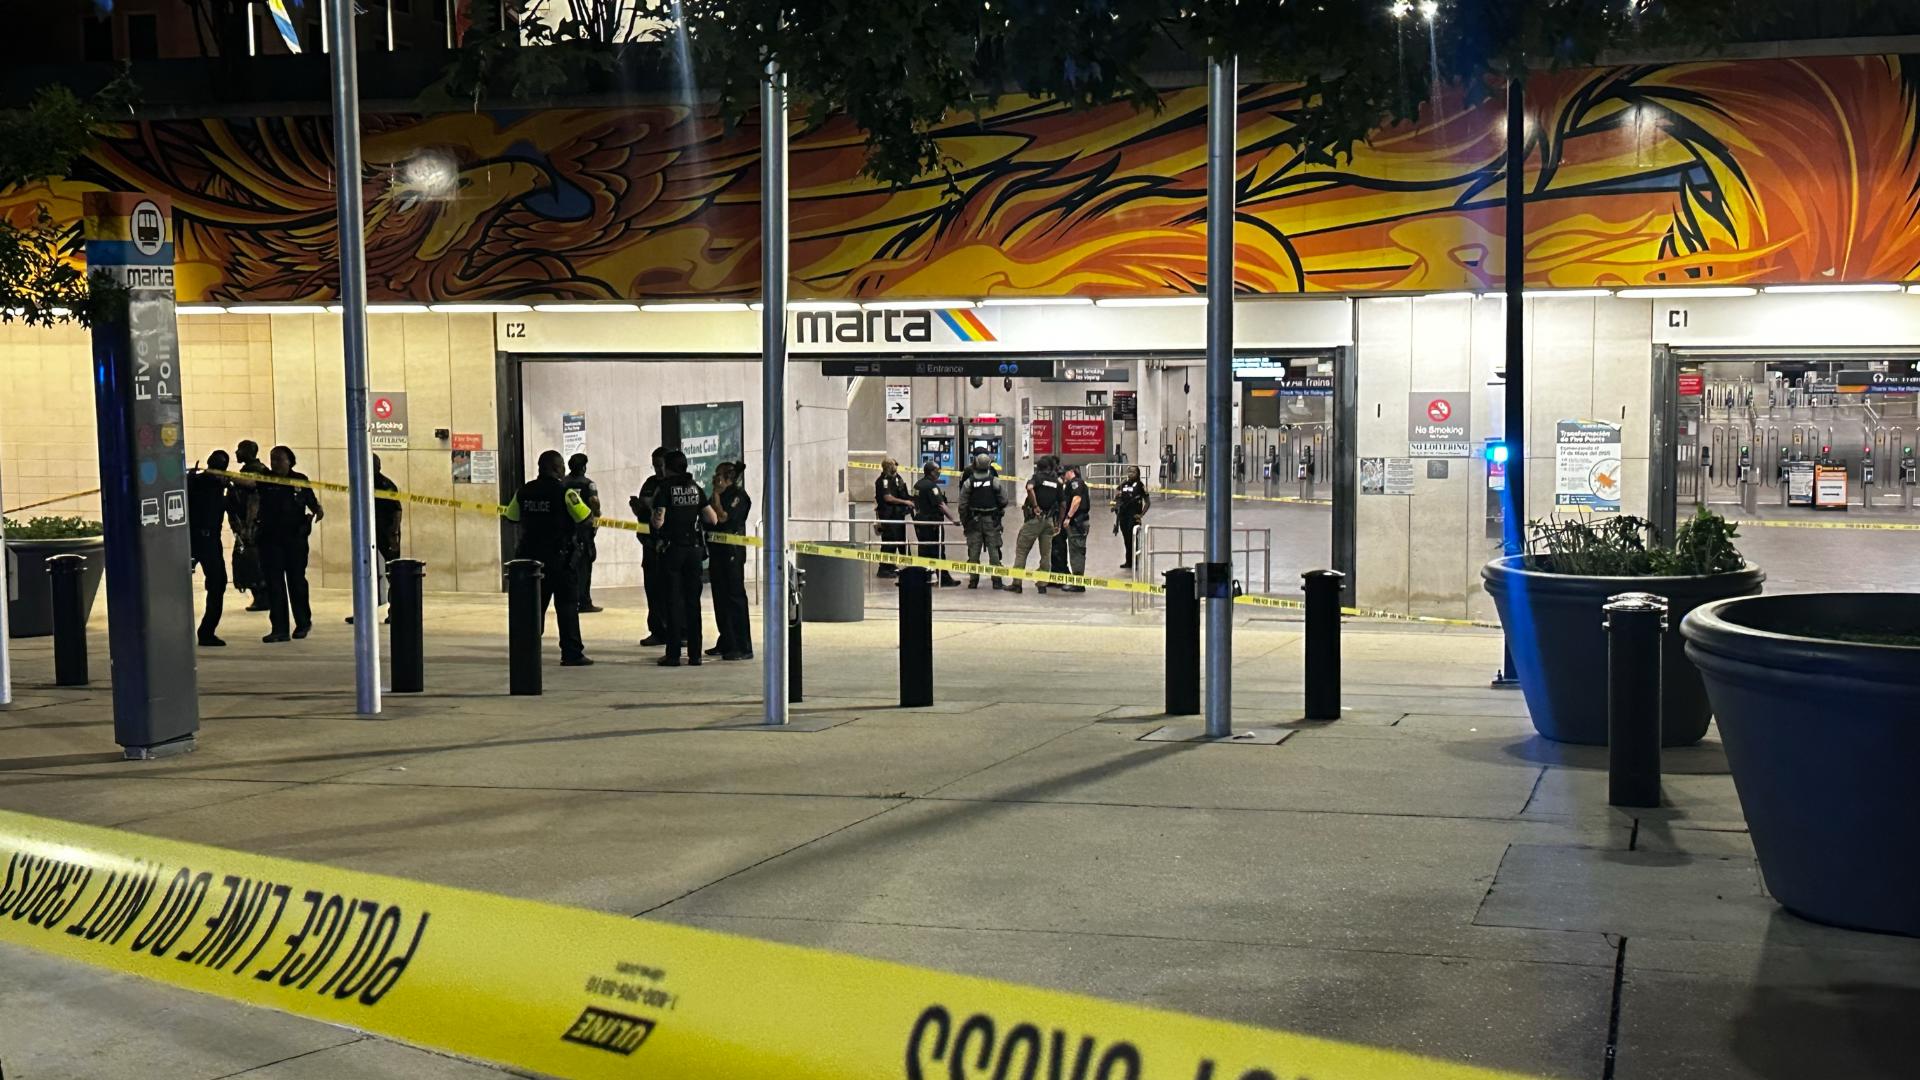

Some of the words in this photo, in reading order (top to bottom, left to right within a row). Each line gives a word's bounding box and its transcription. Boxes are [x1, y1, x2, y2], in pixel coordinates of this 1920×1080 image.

[127, 267, 174, 287] marta
[797, 310, 931, 342] marta
[1669, 310, 1687, 327] C1
[507, 322, 525, 338] C2
[135, 341, 151, 400] Five
[927, 361, 964, 373] Entrance
[376, 421, 403, 431] Smoking
[1415, 425, 1427, 434] No
[1428, 425, 1463, 436] Smoking
[1411, 443, 1423, 451] NO
[1424, 443, 1468, 451] LOITERING
[523, 500, 551, 512] POLICE
[673, 495, 699, 505] POLICE
[0, 852, 94, 929] CROSS
[64, 862, 163, 945] NOT
[131, 867, 212, 956] DO
[175, 875, 293, 975] LINE
[254, 890, 430, 1005] POLICE
[568, 1011, 648, 1051] ULINE
